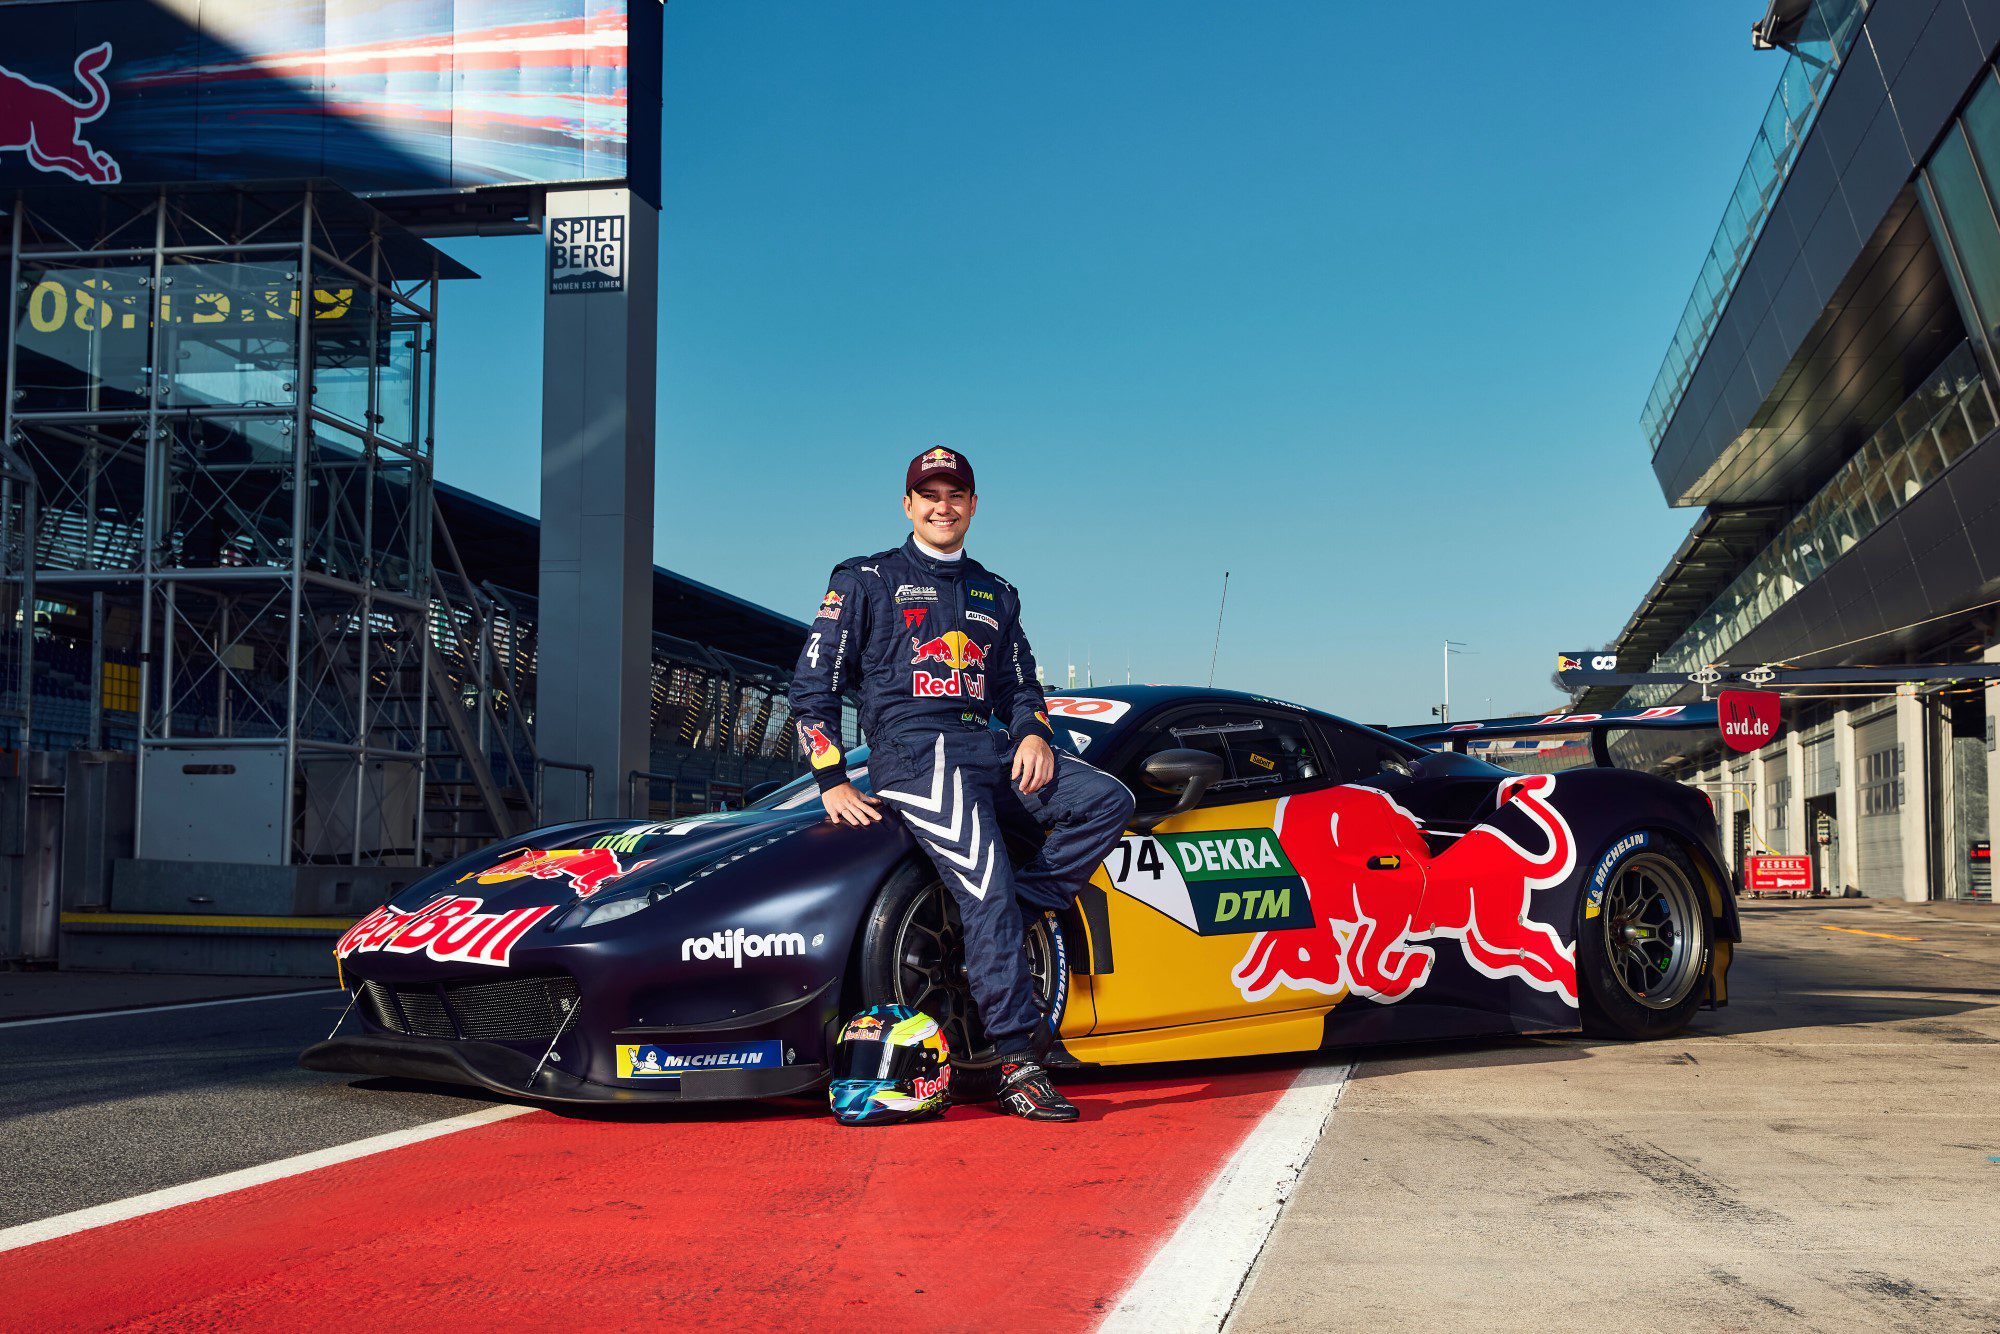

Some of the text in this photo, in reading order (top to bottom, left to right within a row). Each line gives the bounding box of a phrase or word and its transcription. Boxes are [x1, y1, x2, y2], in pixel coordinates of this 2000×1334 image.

[553, 218, 622, 244] SPIEL
[553, 243, 615, 269] BERG
[553, 279, 621, 291] NOMEN EST OMEN
[970, 589, 993, 601] DTM
[831, 629, 848, 692] GIVES YOU WINGS
[913, 669, 985, 700] Red Bull
[1726, 717, 1769, 736] avd.de
[592, 833, 646, 853] DTM
[1176, 836, 1282, 873] DEKRA
[1595, 833, 1644, 888] MICHELIN
[1759, 860, 1802, 869] KESSEL
[1214, 888, 1290, 923] DTM
[336, 895, 561, 968] Red Bull
[681, 928, 806, 969] rotiform
[1051, 934, 1067, 1025] MICHELIN
[844, 1029, 882, 1041] Red Bull
[664, 1052, 763, 1068] MICHELIN
[913, 1065, 944, 1100] Red
